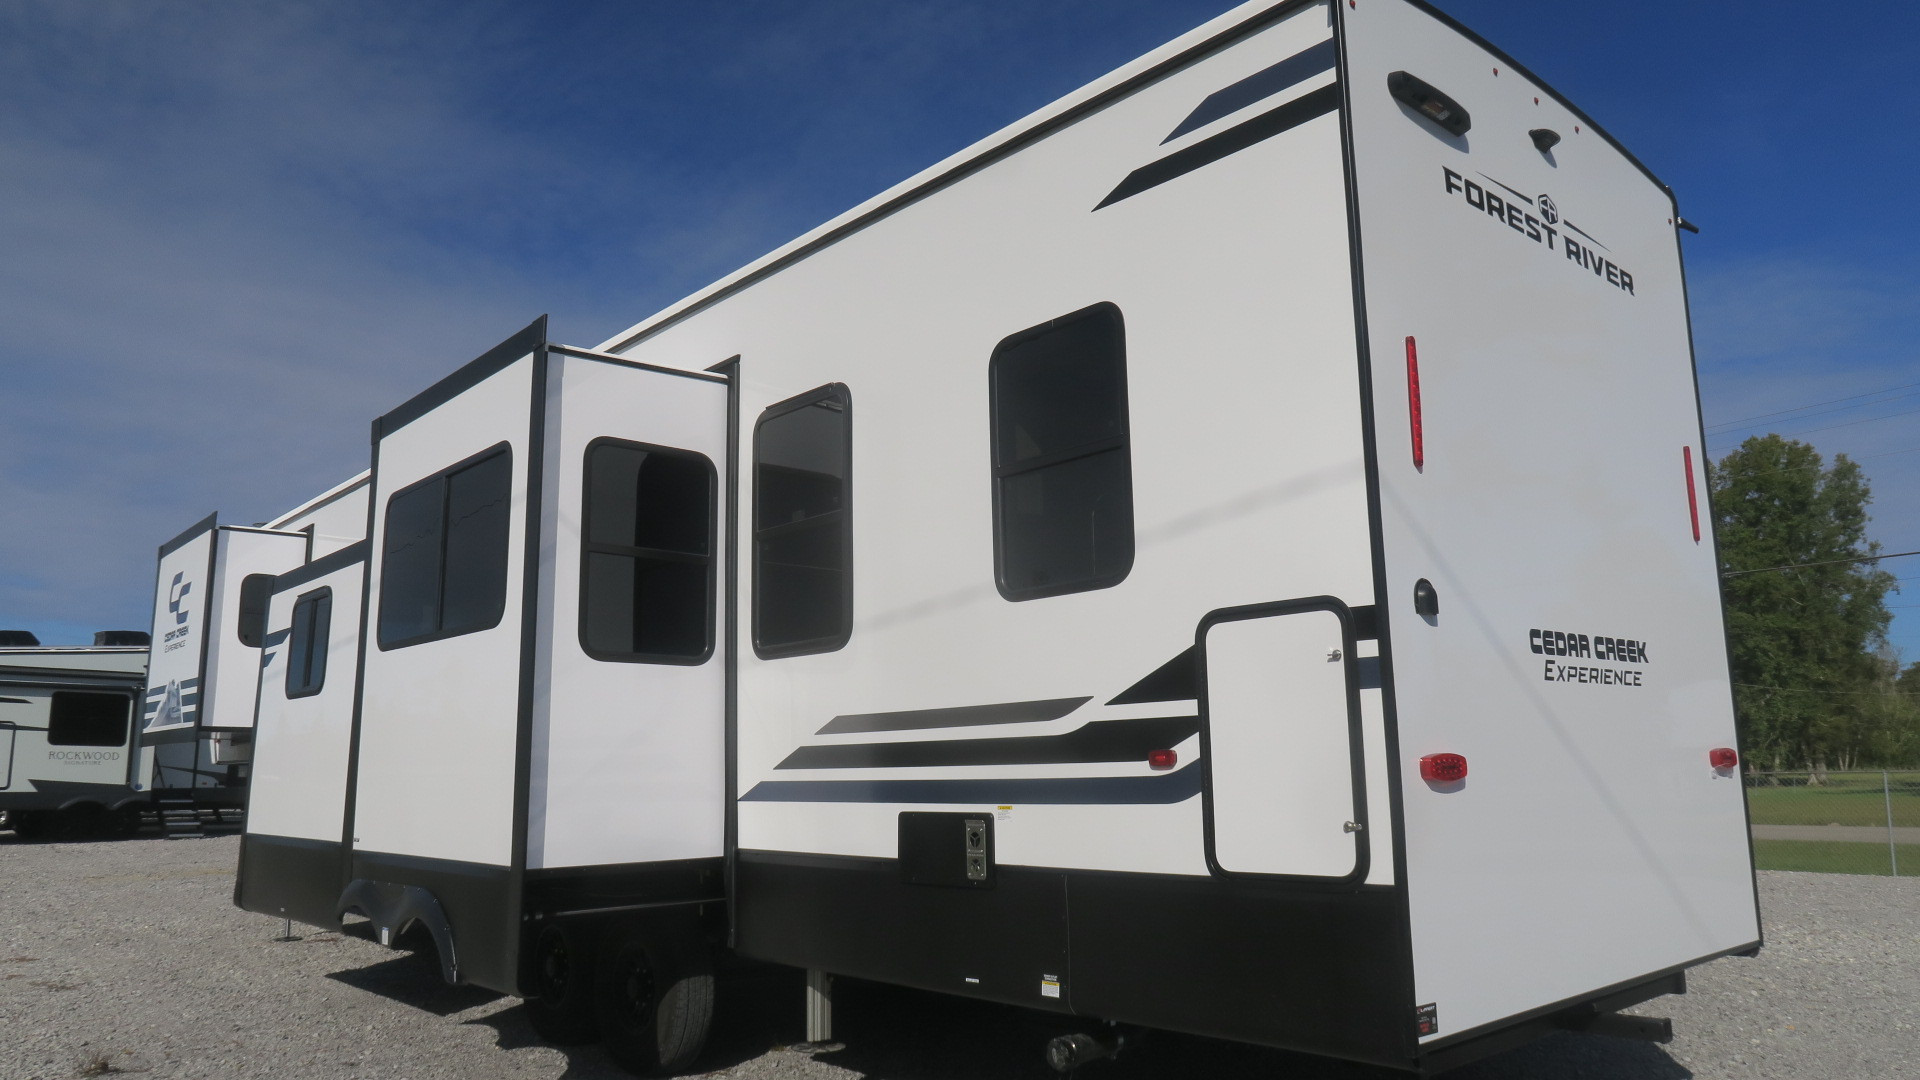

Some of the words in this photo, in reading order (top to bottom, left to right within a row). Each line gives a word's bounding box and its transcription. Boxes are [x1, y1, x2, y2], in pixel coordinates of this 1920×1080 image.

[1442, 165, 1557, 250] FOREST
[1563, 235, 1635, 296] RIVER
[1529, 628, 1591, 659] CEDAR
[1594, 636, 1649, 663] CREEK
[1544, 659, 1643, 687] EXPERIENCE
[48, 751, 120, 760] ROCKWOOD
